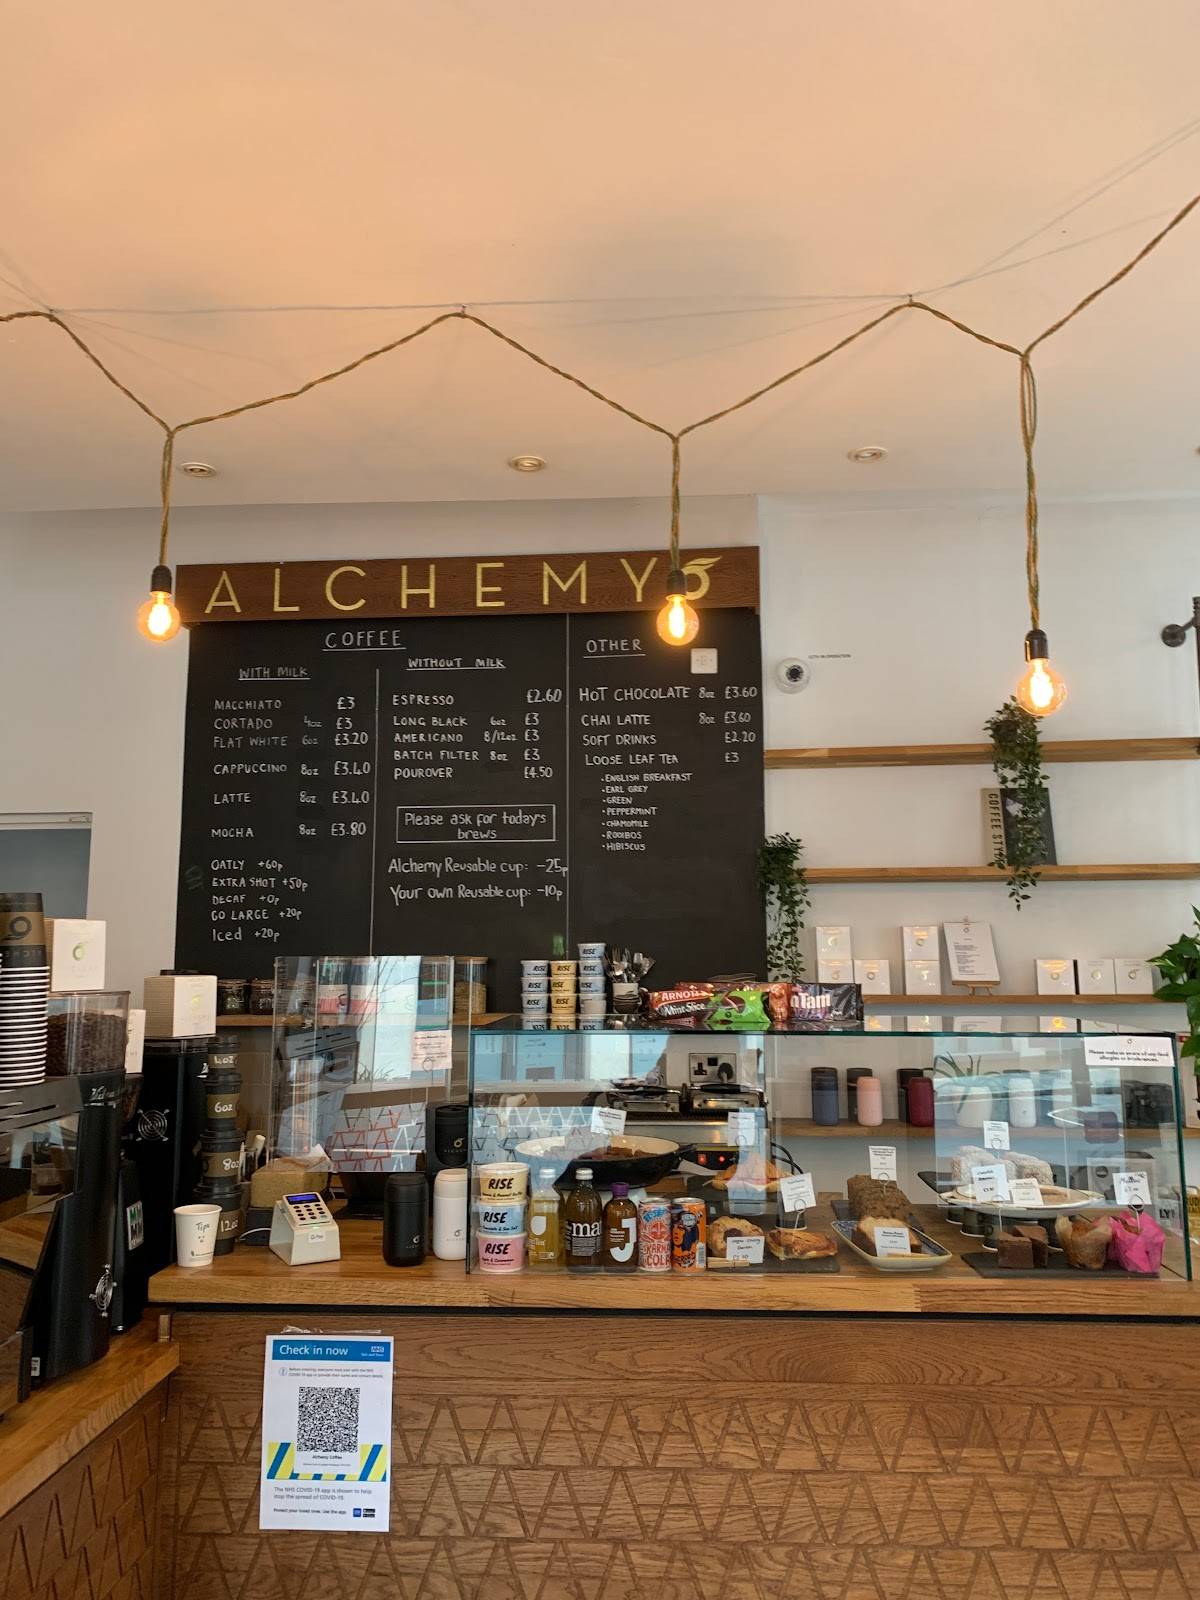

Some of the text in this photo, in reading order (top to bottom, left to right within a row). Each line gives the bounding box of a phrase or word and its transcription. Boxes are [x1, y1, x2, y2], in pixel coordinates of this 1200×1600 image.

[204, 557, 658, 614] ALCHEMY
[325, 630, 401, 648] COFFEE
[586, 639, 642, 653] OTHER
[408, 657, 504, 668] WITHOUT MILK
[239, 667, 308, 678] WITH MILK
[393, 689, 562, 706] ESPRESSO £2.60
[579, 686, 757, 701] HOT CHOCOLATE 8oz £3.60
[214, 696, 355, 710] MACCHIATO £3
[213, 718, 273, 730] CORTADO
[336, 717, 353, 730] £3
[393, 715, 426, 726] LONG
[432, 716, 469, 726] BLACK
[525, 712, 539, 726] £3
[581, 711, 751, 727] CHAI LATTE 8oz £3.60
[213, 736, 243, 749] FLAT
[250, 736, 288, 746] WHITE
[335, 732, 368, 746] £3.20
[394, 733, 463, 743] AMERICANO
[525, 729, 540, 742] £3
[583, 732, 756, 746] SOFT DRINKS £2.20
[394, 750, 433, 761] BATCH
[440, 750, 480, 761] FILTER
[524, 749, 540, 761] £3
[585, 752, 739, 766] LOOSE LEAF TEA £3
[213, 761, 371, 776] CAPPUCCINO 8oz £3.40
[394, 766, 553, 780] POUROVER £4.50
[605, 773, 693, 782] ENGLISH BREAKFAST
[605, 785, 648, 793] EARL GREY
[214, 791, 370, 805] LATTE 8oz £3.40
[606, 796, 633, 804] GREEN
[606, 807, 657, 815] PEPPERMINT
[988, 793, 1002, 829] COFFEE
[405, 812, 444, 826] Please
[450, 813, 473, 825] ask
[477, 813, 497, 827] for
[211, 822, 367, 838] MOCHA 8oz £3.80
[458, 828, 497, 840] brews
[606, 842, 646, 851] HIBISCUS
[211, 859, 283, 872] OATLY +60p
[388, 858, 442, 878] Alchemy
[445, 857, 497, 873] Reusable
[500, 862, 528, 878] cup:
[212, 877, 308, 892] EXTRA SHOT +50p
[212, 894, 280, 905] DECAF +0p
[390, 884, 423, 906] Your
[428, 887, 453, 899] own
[458, 884, 503, 899] Reusable
[211, 908, 302, 921] GO LARGE +20p
[212, 927, 280, 942] Iced +20p
[214, 1055, 234, 1065] 4oz
[214, 1101, 233, 1113] 6oz
[223, 1158, 240, 1171] 8oz
[488, 1177, 514, 1190] RISE
[484, 1211, 508, 1224] RISE
[571, 1221, 602, 1238] ma
[485, 1243, 511, 1255] RISE
[279, 1344, 349, 1356] Check in now
